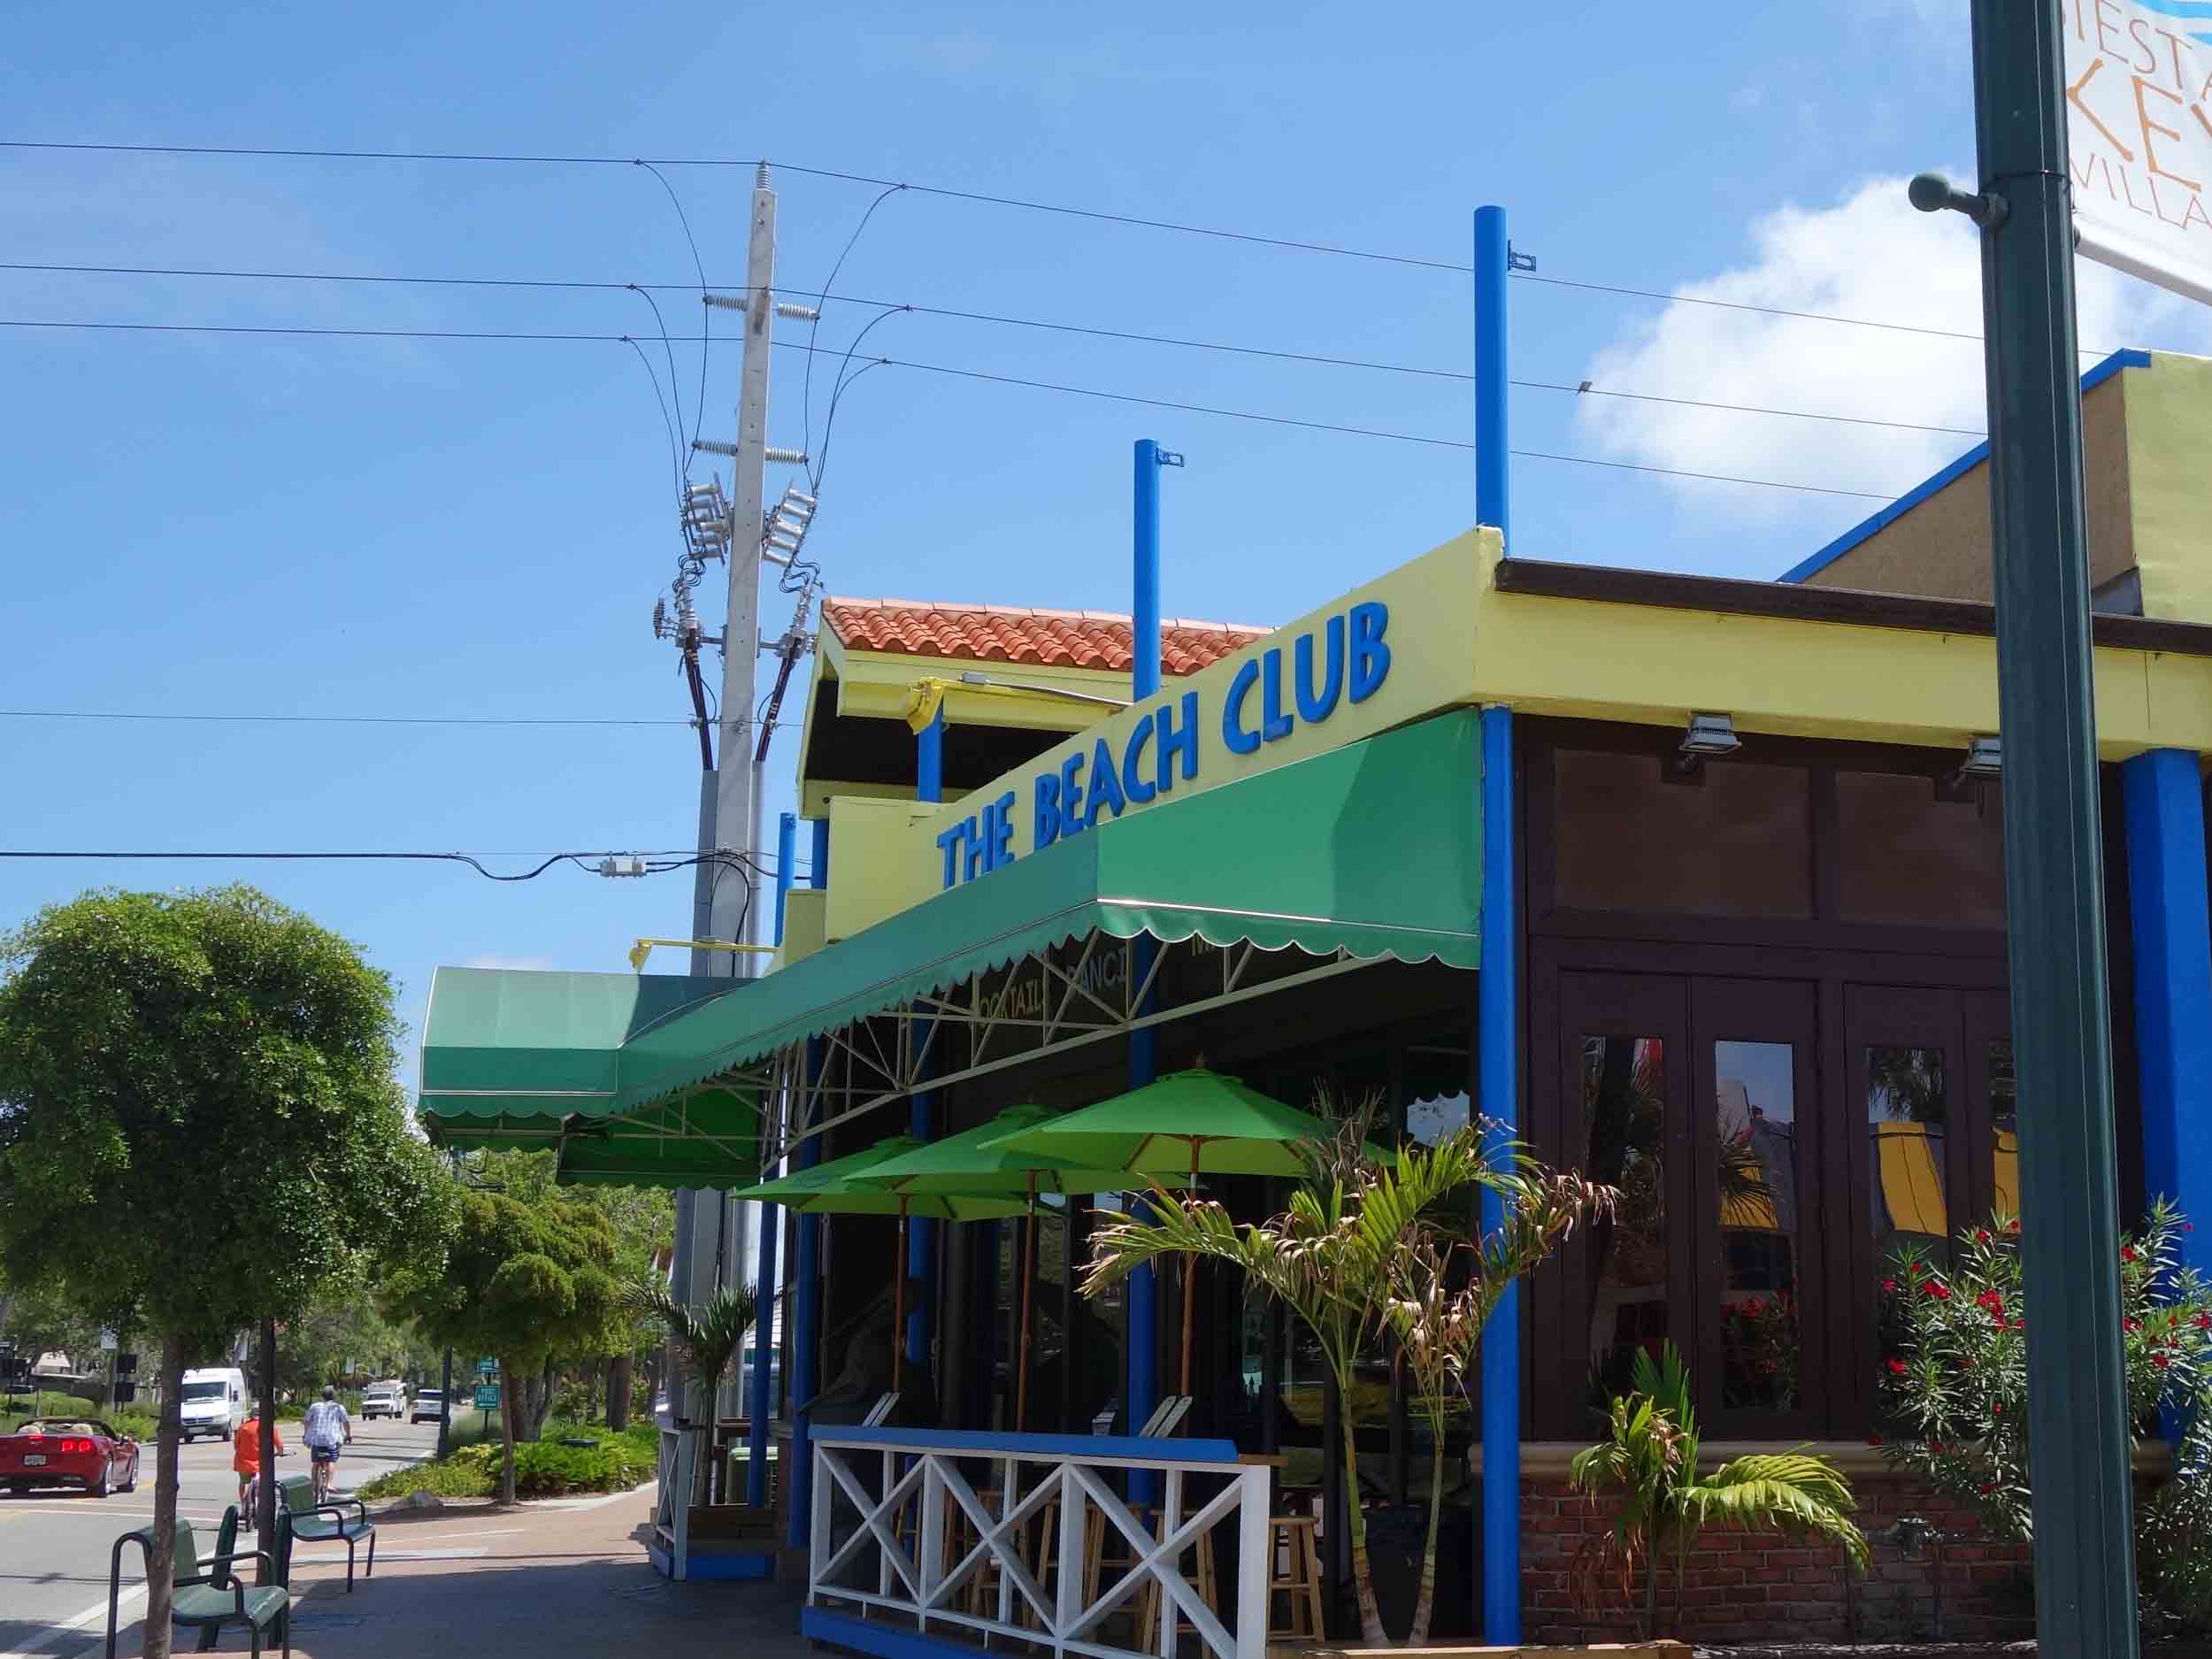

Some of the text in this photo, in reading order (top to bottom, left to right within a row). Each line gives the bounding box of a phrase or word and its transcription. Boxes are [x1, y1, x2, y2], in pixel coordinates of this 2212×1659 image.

[2062, 0, 2212, 101] IEST
[936, 602, 1392, 890] THE BEACH CLUB
